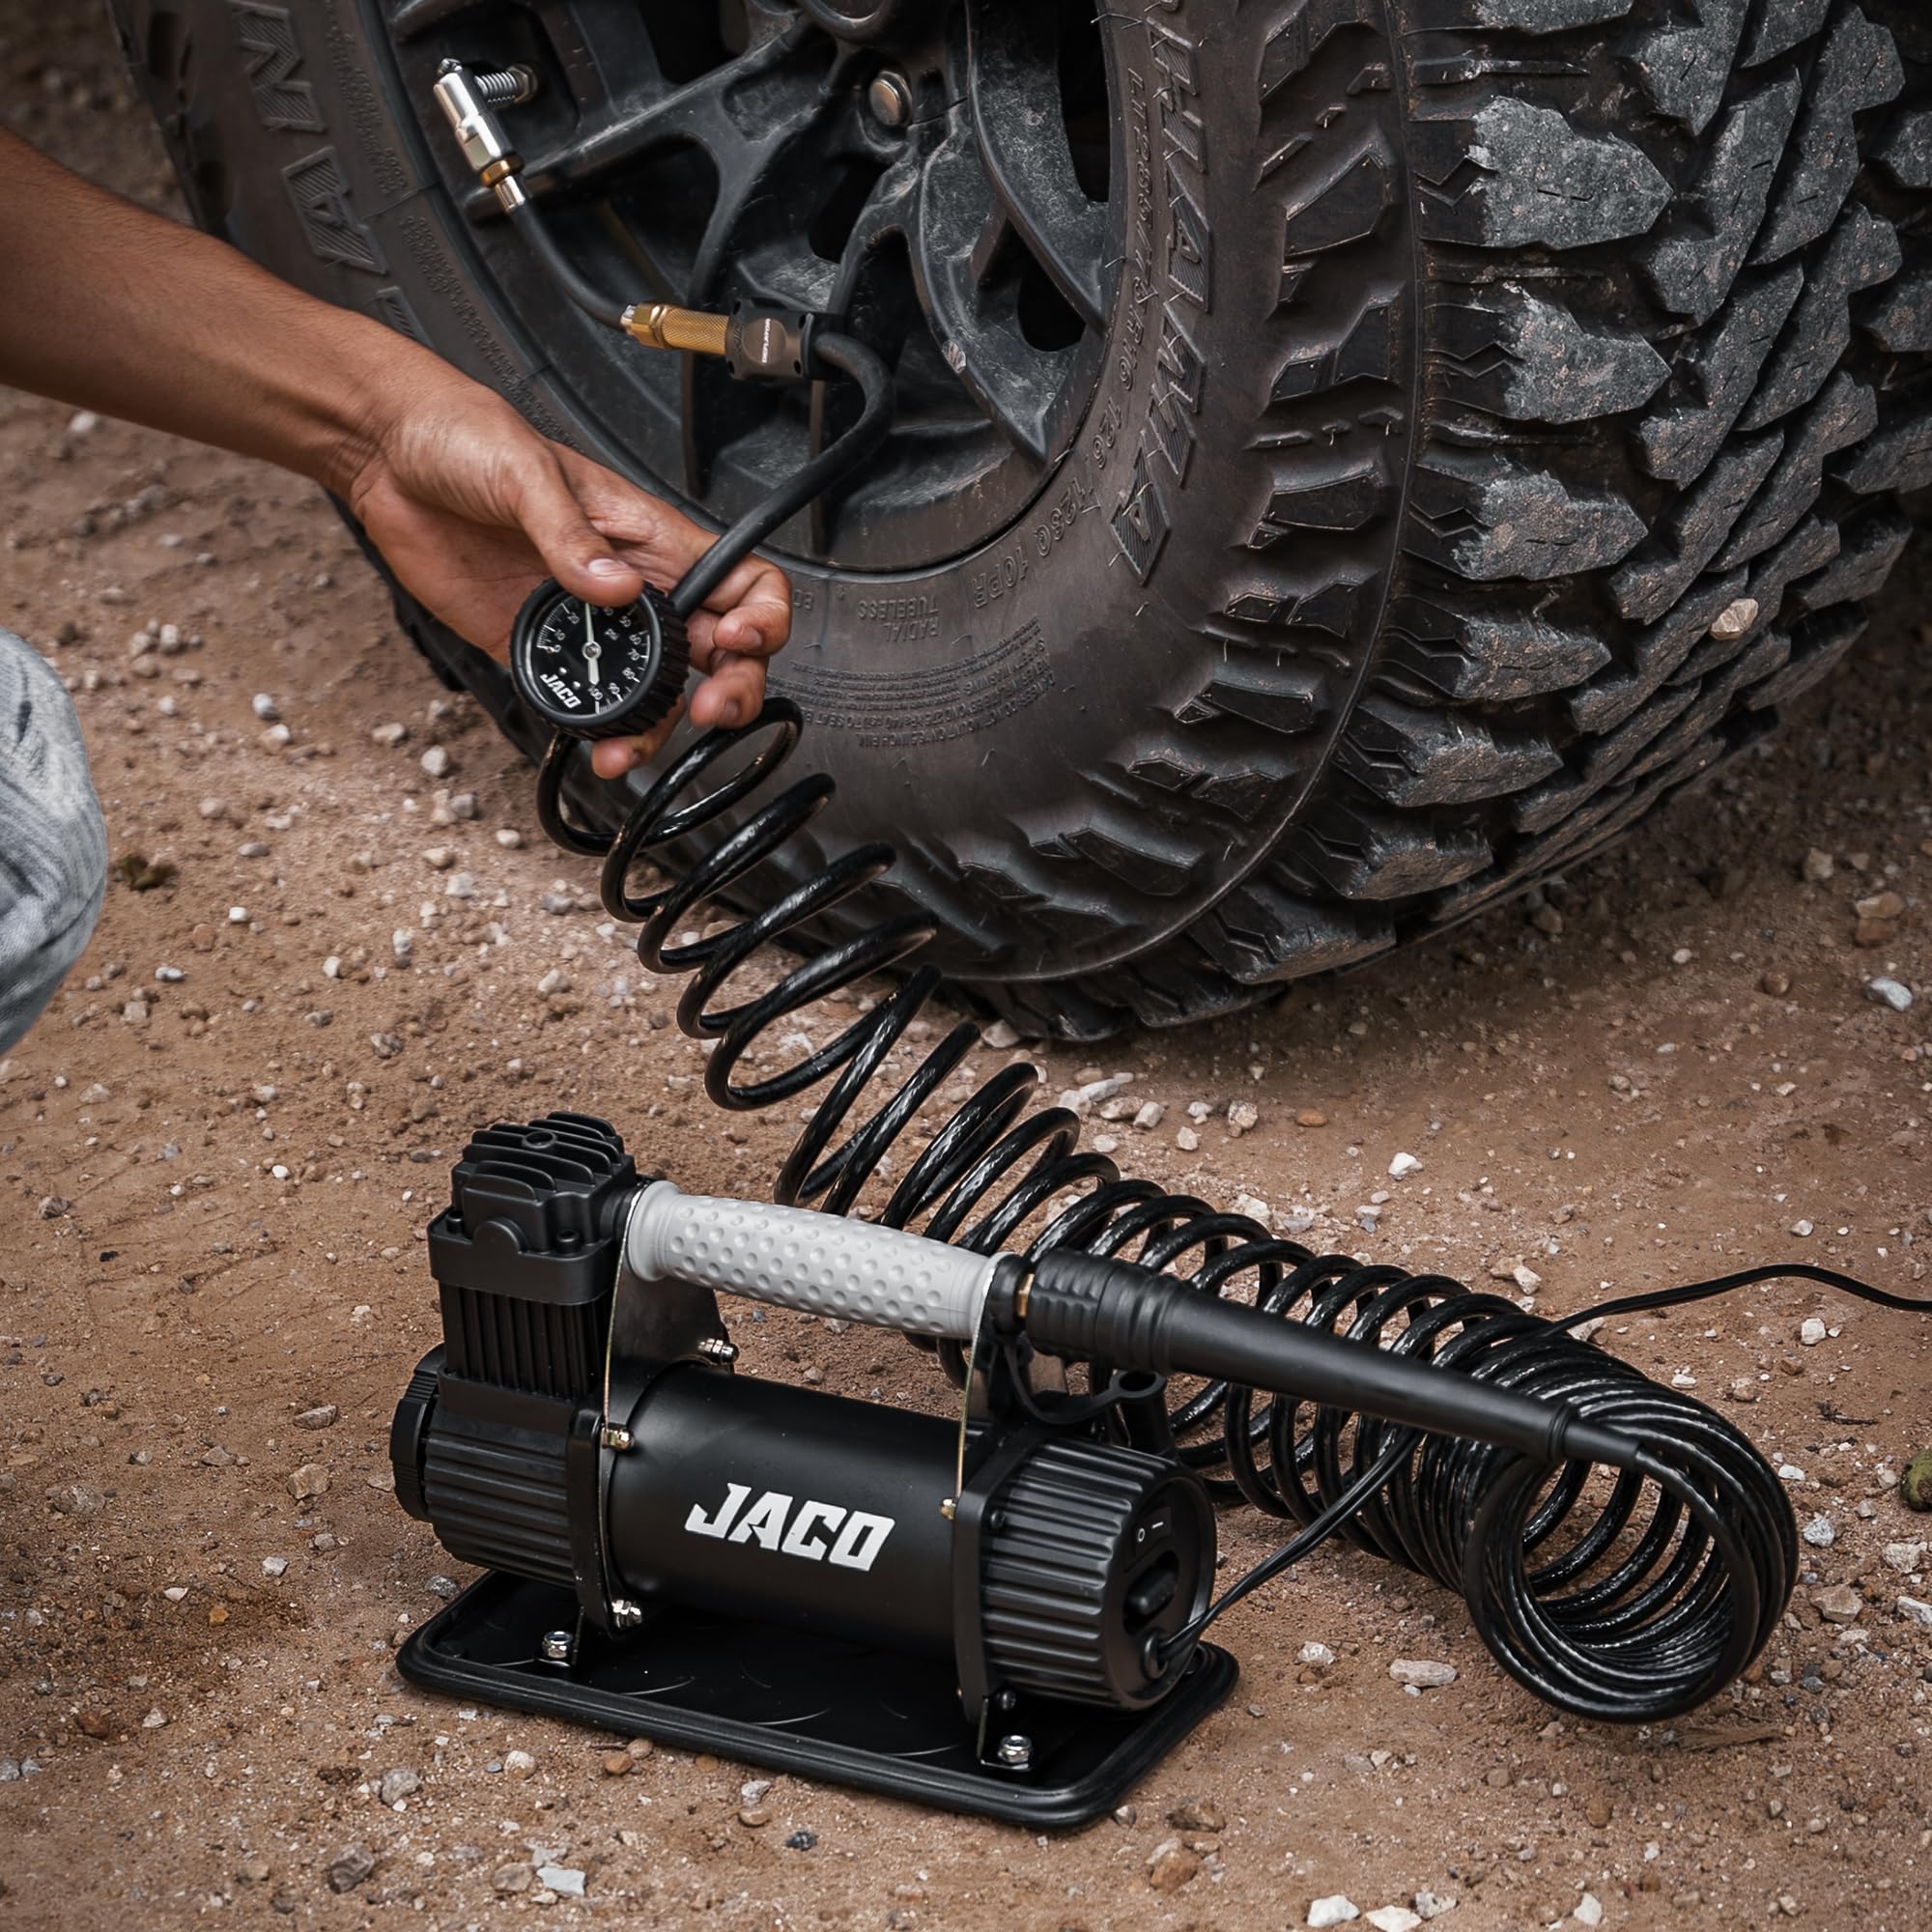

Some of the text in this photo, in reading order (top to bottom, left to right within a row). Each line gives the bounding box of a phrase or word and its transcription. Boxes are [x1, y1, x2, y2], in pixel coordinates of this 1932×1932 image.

[1110, 0, 1210, 585] HAMA
[858, 595, 940, 620] TUBELESS
[883, 618, 940, 642] RADIAL
[539, 673, 582, 709] JACO
[685, 1482, 896, 1572] JACO
